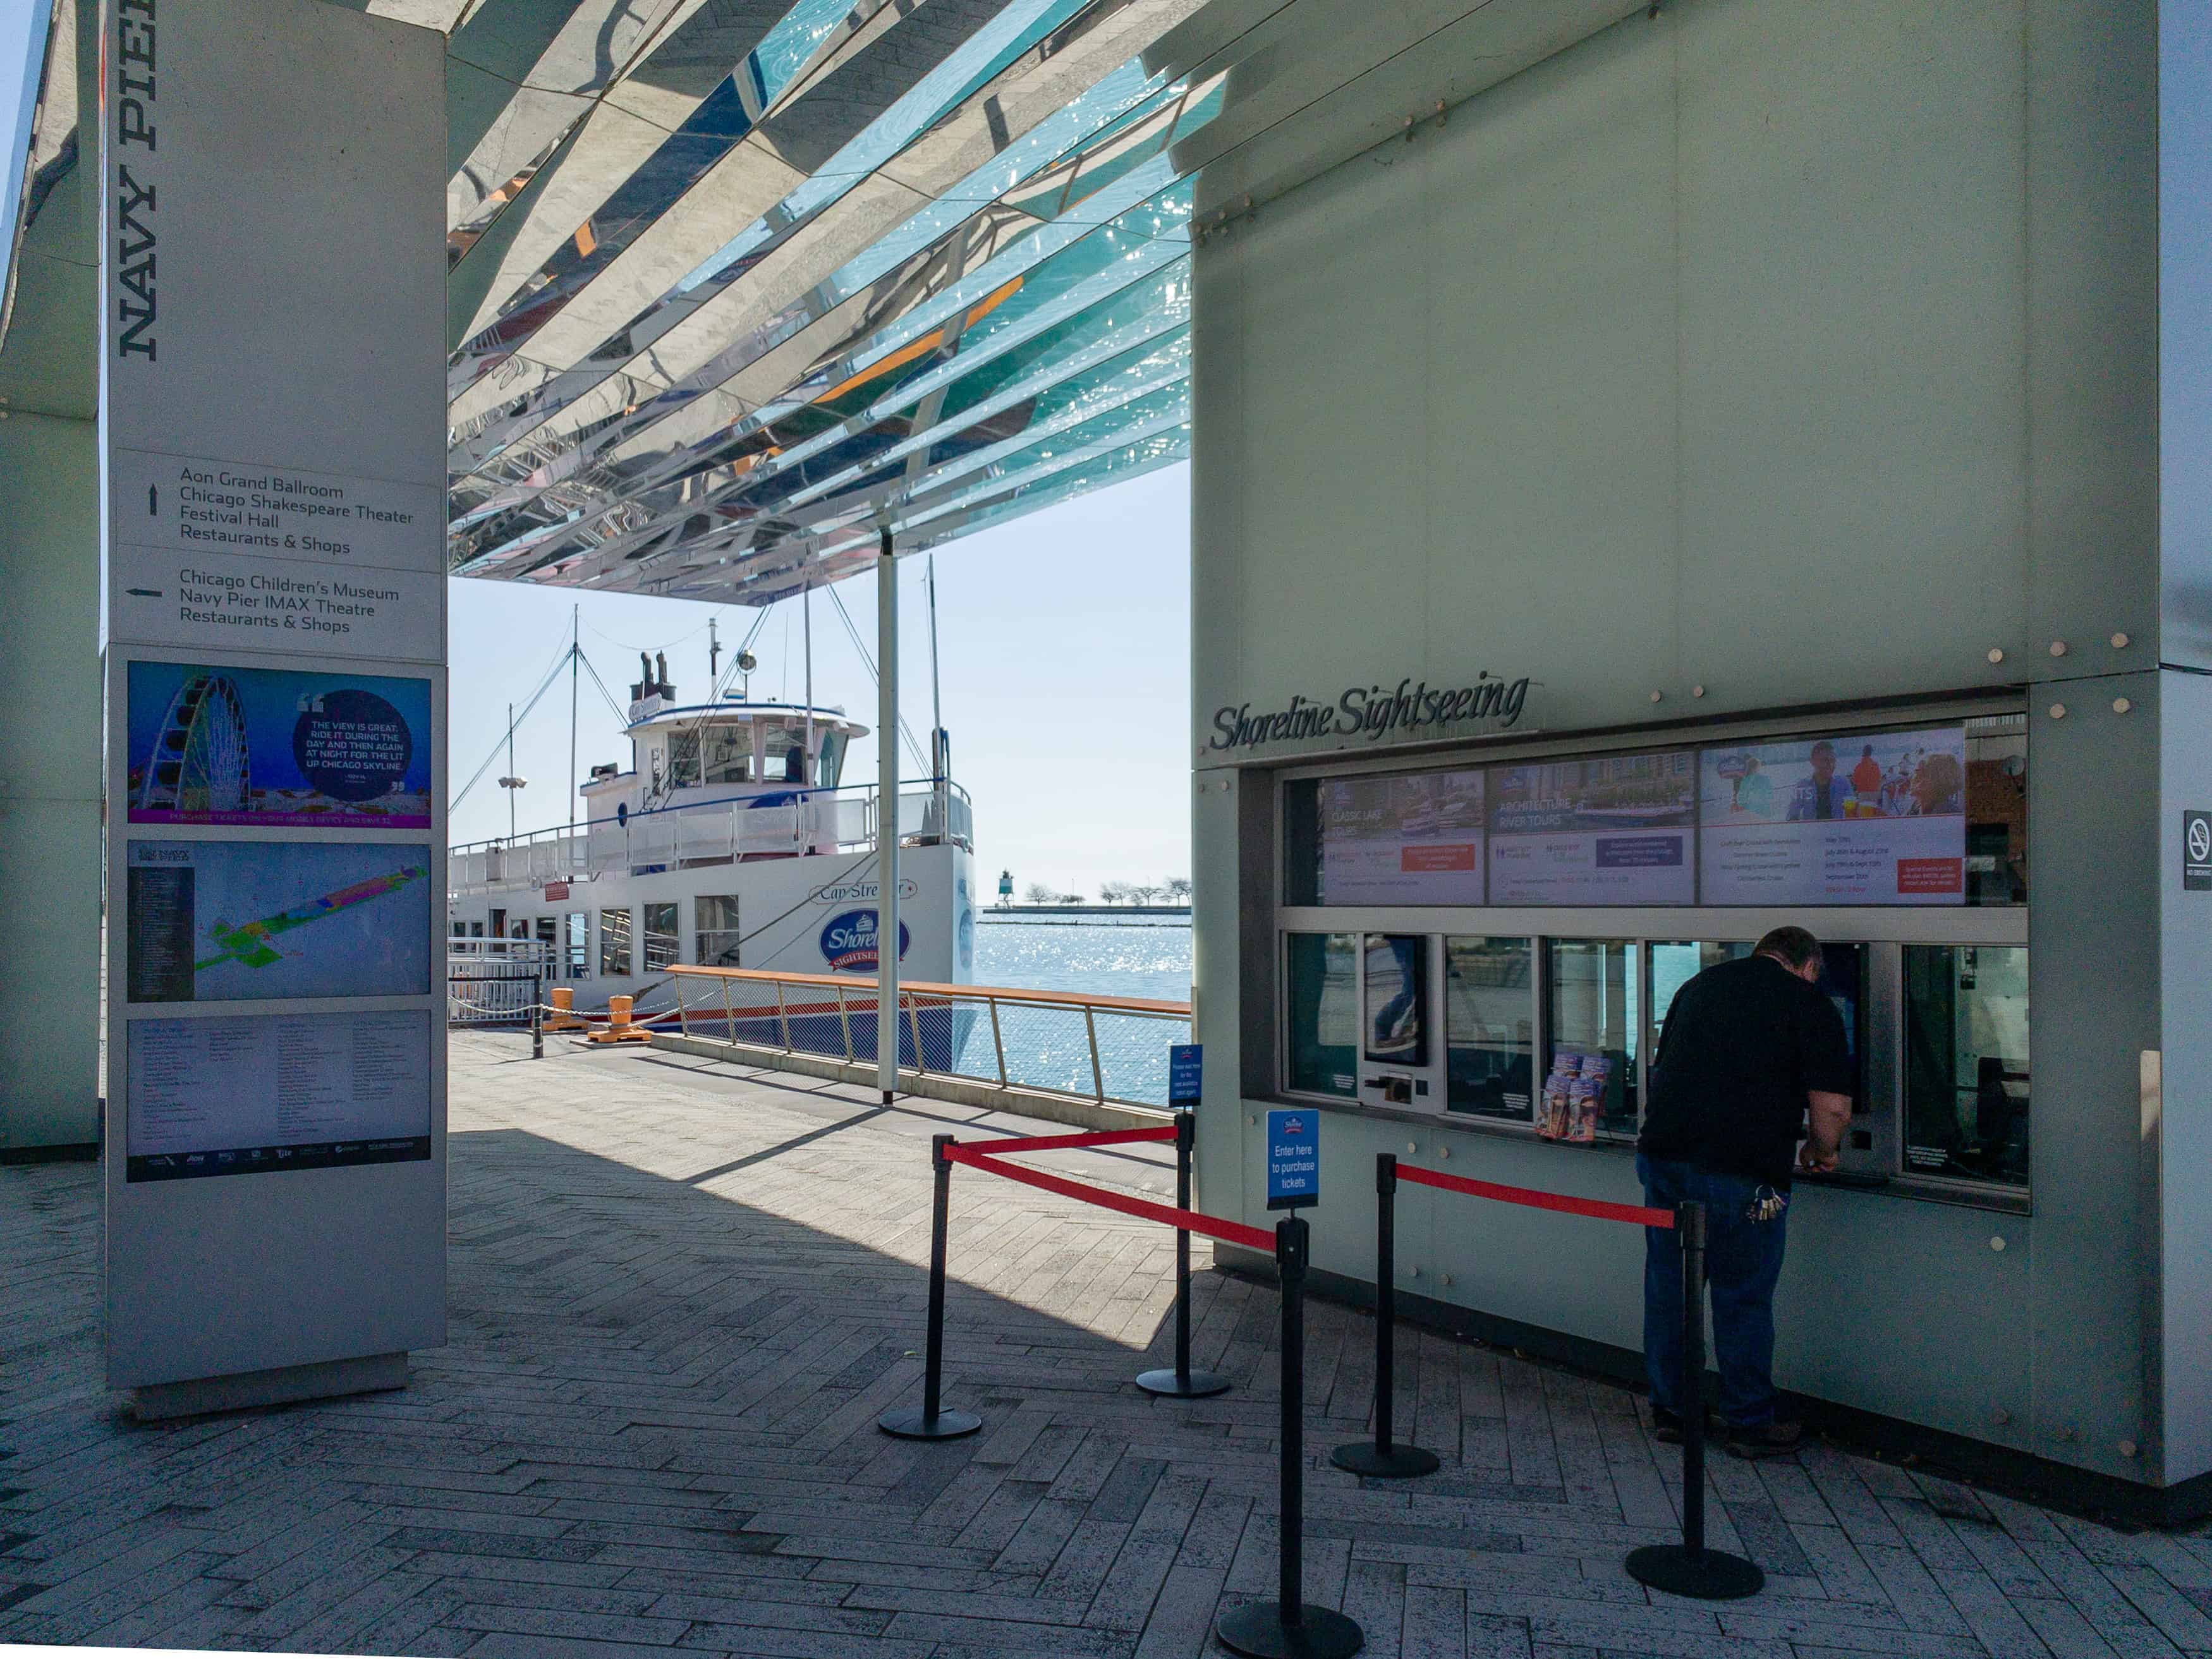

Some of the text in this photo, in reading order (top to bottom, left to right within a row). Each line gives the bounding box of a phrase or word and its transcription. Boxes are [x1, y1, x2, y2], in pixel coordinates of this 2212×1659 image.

[119, 164, 156, 362] NAVY
[180, 467, 344, 499] Aon Grand Ballroom
[180, 487, 414, 525] Chicago Shakespeare Theater
[180, 506, 279, 528] Festival Hall
[180, 525, 351, 556] Restaurants & Shops
[180, 569, 400, 602] Chicago Children's Museum
[180, 589, 375, 617] Navy Pier IMAX Theatre
[180, 607, 349, 635] Restaurants & Shops
[1208, 671, 1529, 751] Shoreline Sightseeing
[312, 720, 330, 730] THE
[332, 722, 355, 730] VIEW
[357, 722, 366, 731] IS
[311, 731, 332, 739] RIDE
[345, 732, 379, 741] DURING
[381, 733, 399, 742] THE
[307, 740, 403, 751] DAY AND THEN AGAIN
[306, 750, 404, 761] AT NIGHT FOR THE LIT
[307, 760, 320, 768] UP
[321, 760, 361, 769] CHICAGO
[1499, 798, 1571, 811] ARCHITECTURE
[1332, 810, 1362, 822] CLASSIC
[1500, 814, 1562, 828] RIVER TOURS
[849, 882, 904, 897] Strer
[829, 928, 880, 949] Shorel
[834, 952, 880, 968] SIGHTSEE
[1275, 1145, 1313, 1157] Enter here
[1272, 1161, 1315, 1176] to purchase
[1282, 1177, 1306, 1189] tickets
